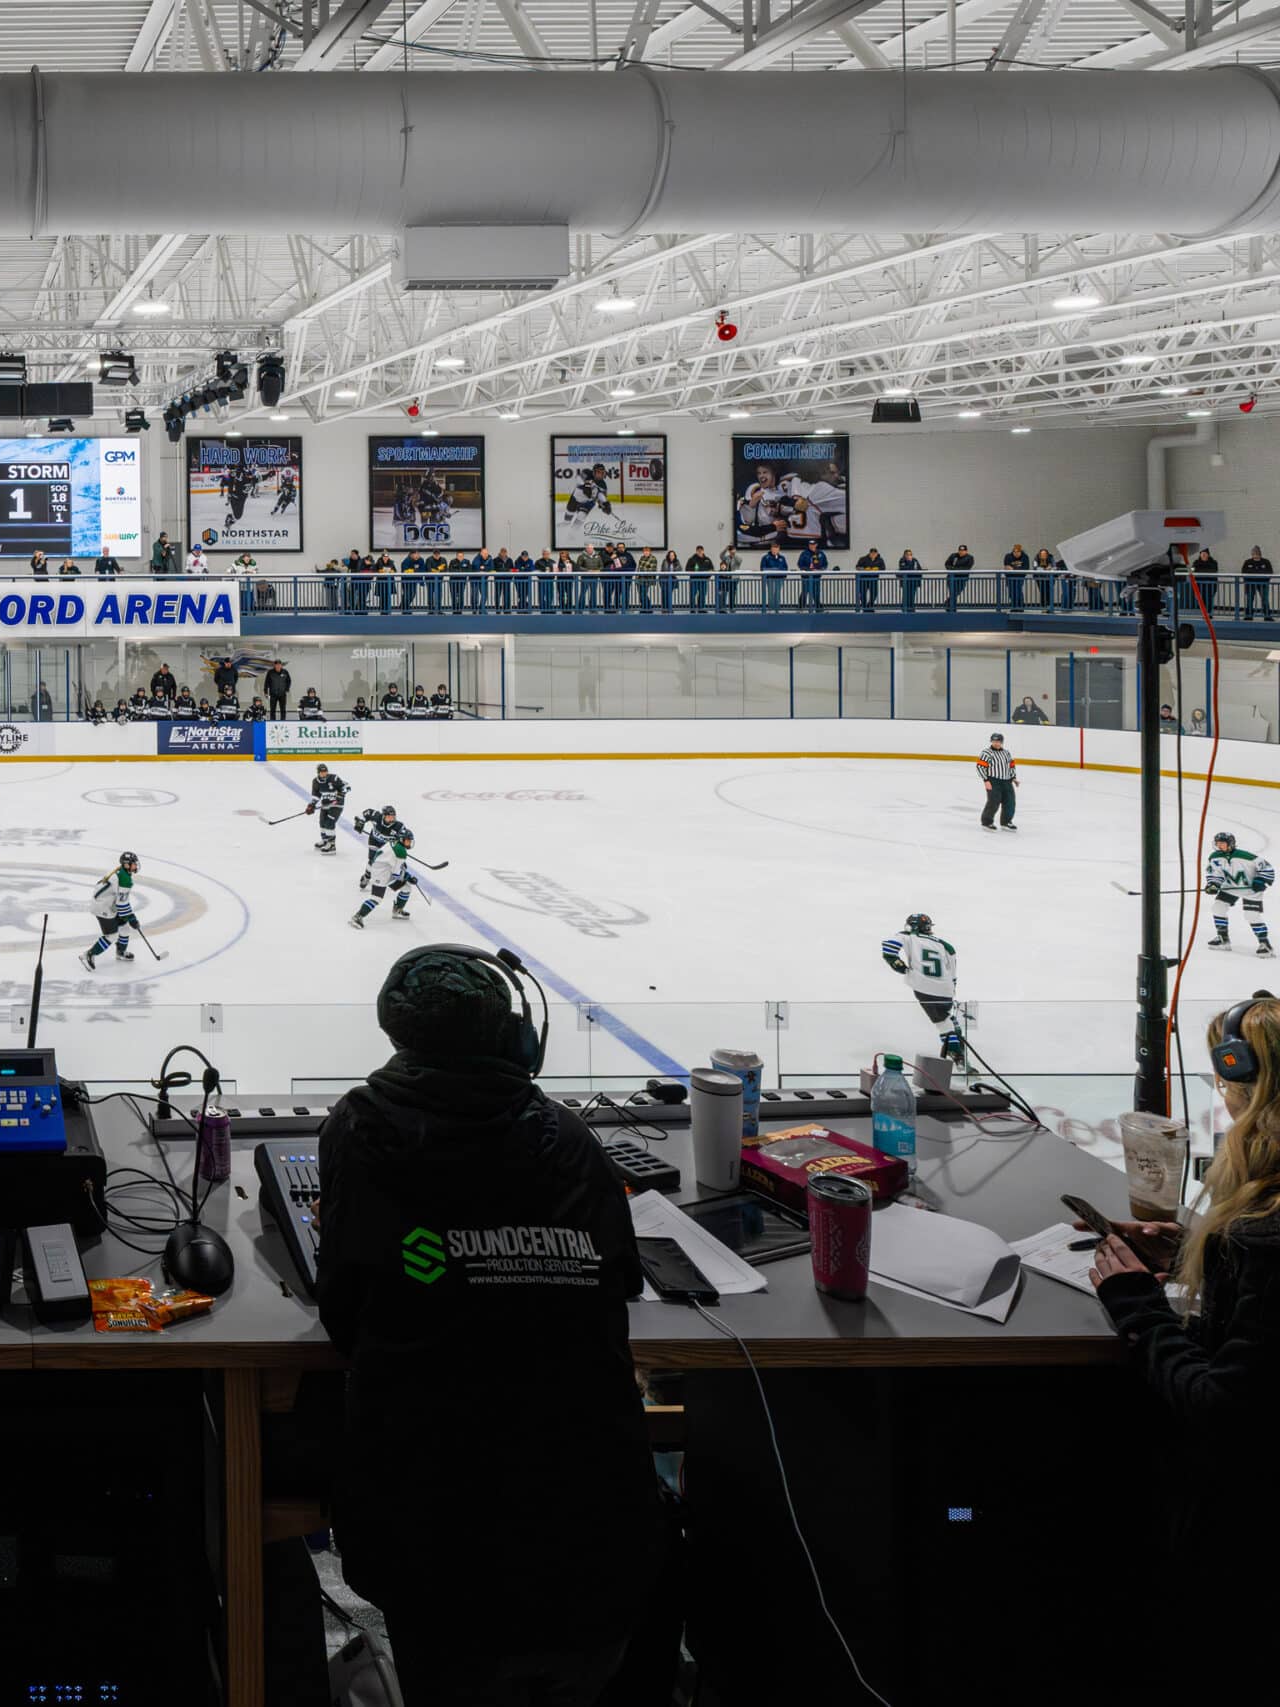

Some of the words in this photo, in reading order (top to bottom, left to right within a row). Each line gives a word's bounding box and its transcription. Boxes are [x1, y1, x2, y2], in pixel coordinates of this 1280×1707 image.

[104, 451, 136, 463] GPM
[201, 448, 240, 464] HARD
[244, 448, 288, 464] WORK
[744, 443, 837, 459] COMMITMENT
[8, 465, 68, 479] STORM
[8, 488, 32, 519] 1
[51, 493, 67, 503] 18
[55, 514, 64, 522] 1
[221, 530, 289, 538] NORTHSTAR
[404, 523, 450, 541] DCS
[94, 594, 235, 625] ARENA
[351, 648, 406, 659] SUBWAY
[189, 727, 242, 737] NorthStar
[298, 726, 360, 738] Reliable
[420, 789, 588, 801] Coca-Cola
[1223, 869, 1249, 886] M
[922, 950, 942, 977] 5
[1139, 987, 1148, 996] B
[1140, 1047, 1148, 1056] C
[447, 1226, 602, 1260] SOUNDCENTRAL
[487, 1258, 542, 1272] PRODUCTION
[544, 1260, 582, 1274] SERVICES
